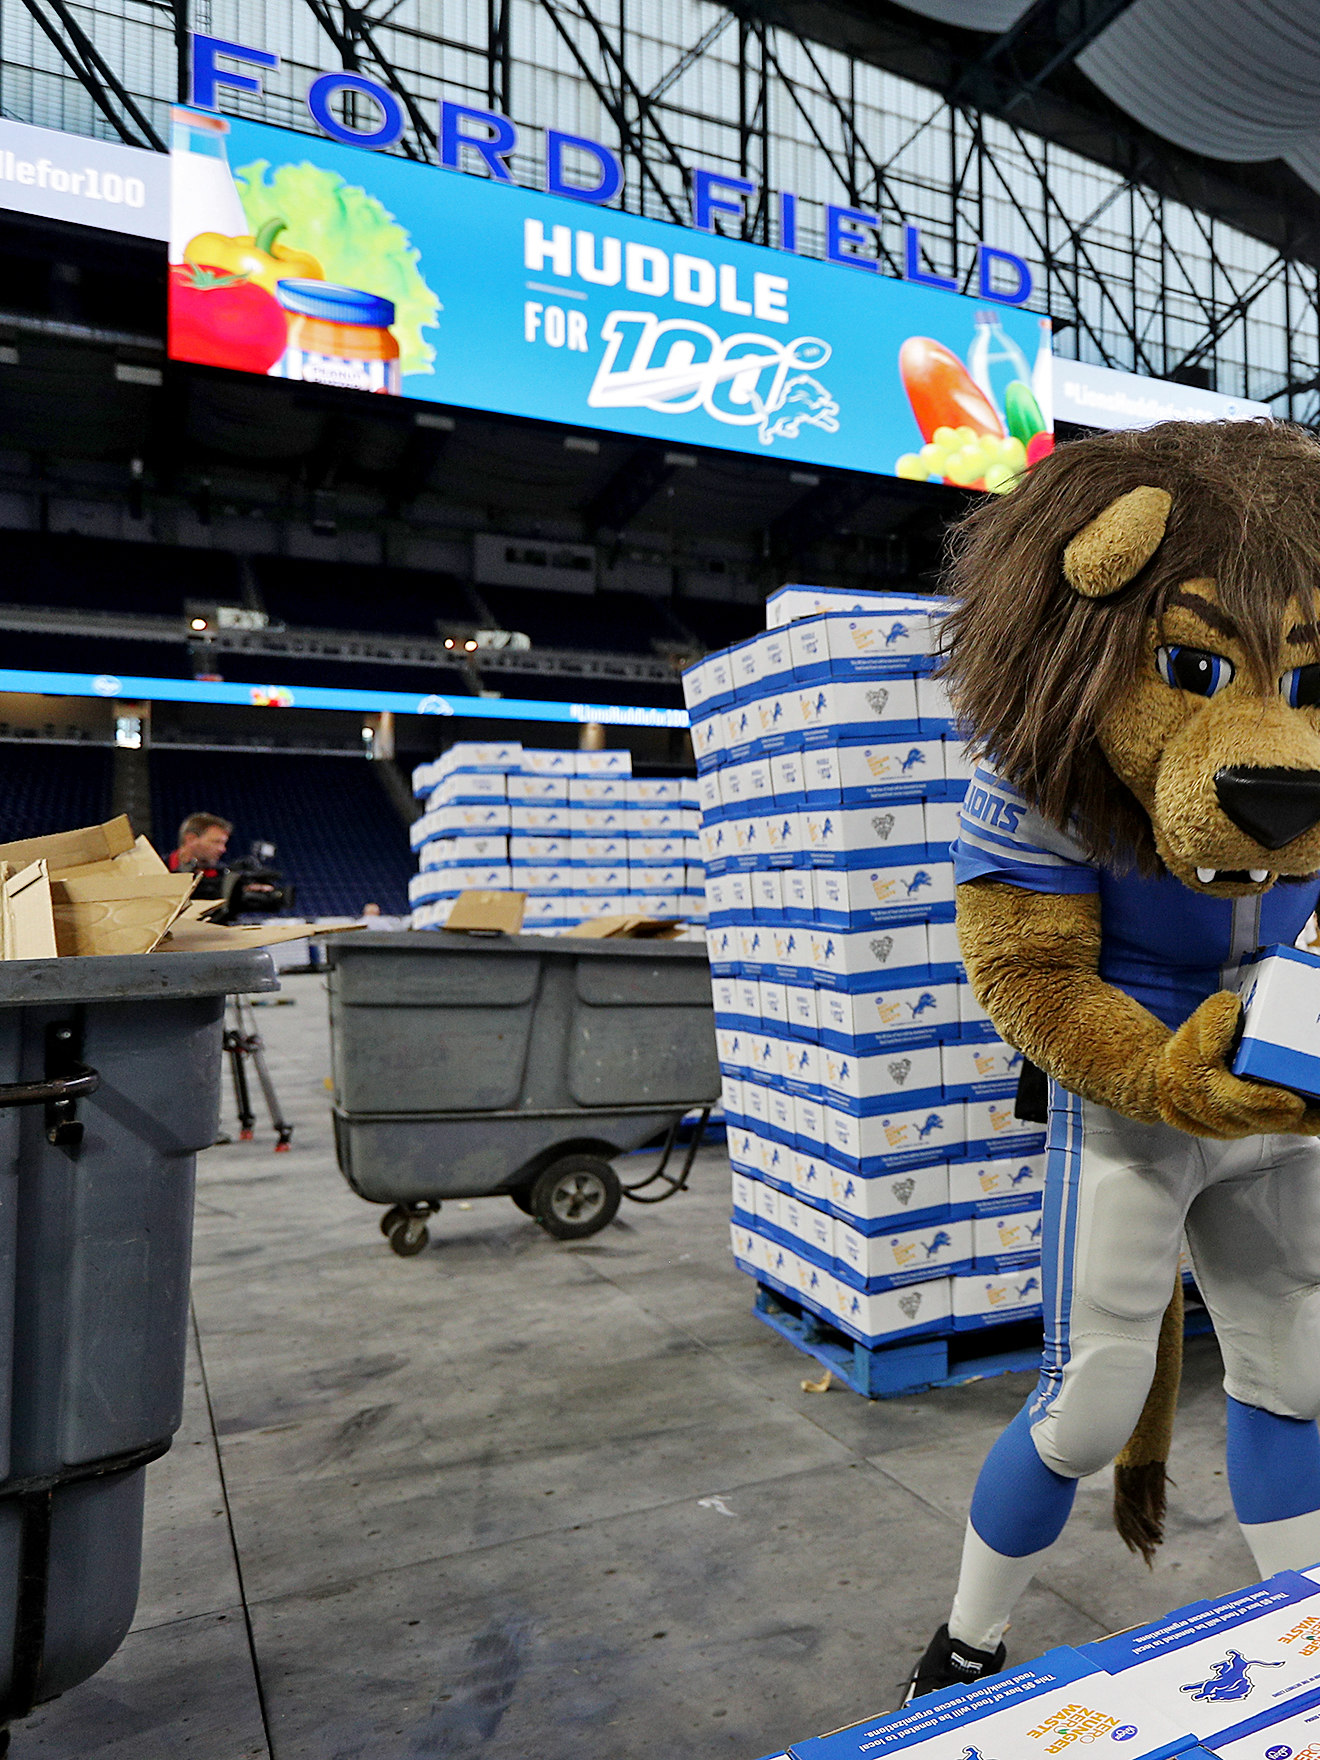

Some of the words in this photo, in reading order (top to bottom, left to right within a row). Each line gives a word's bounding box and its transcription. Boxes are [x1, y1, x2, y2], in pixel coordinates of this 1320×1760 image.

[187, 30, 625, 205] FORD
[691, 166, 1035, 307] FIELD
[523, 217, 790, 325] HUDDLE
[523, 300, 589, 352] FOR
[588, 310, 800, 428] 100
[1278, 1616, 1319, 1644] WASTE
[1012, 1671, 1035, 1683] food
[1021, 1681, 1035, 1689] $5
[1033, 1673, 1055, 1685] This
[965, 1679, 1013, 1700] bank/food
[992, 1692, 1004, 1700] of
[1003, 1685, 1023, 1696] box
[933, 1697, 965, 1713] rescue
[951, 1705, 971, 1716] will
[970, 1697, 993, 1708] food
[863, 1709, 933, 1739] organizations.
[938, 1712, 952, 1721] be
[1026, 1703, 1082, 1739] WASTE
[1054, 1707, 1095, 1734] ZERO
[897, 1717, 938, 1736] donated
[1044, 1711, 1108, 1754] HUNGER
[1080, 1716, 1121, 1744] ZERO
[859, 1738, 884, 1751] local
[884, 1733, 897, 1741] to
